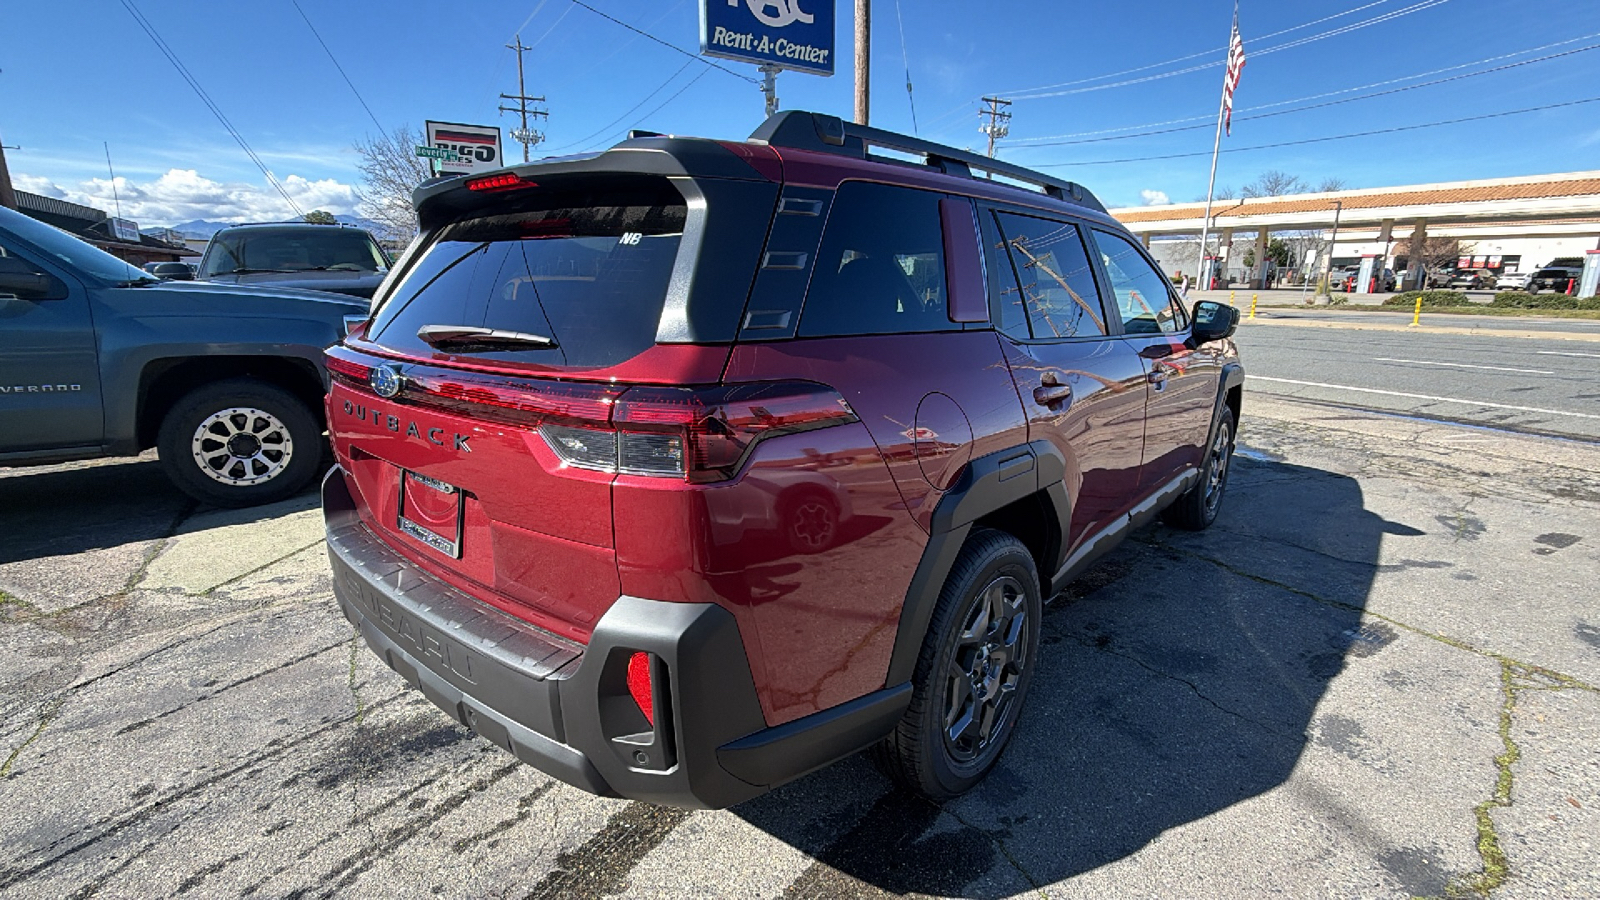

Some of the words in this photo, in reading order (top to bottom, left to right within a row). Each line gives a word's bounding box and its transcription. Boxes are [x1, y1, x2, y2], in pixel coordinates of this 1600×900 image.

[416, 146, 448, 159] Beverly
[619, 232, 643, 245] NB
[344, 400, 472, 453] OUTBACK
[345, 571, 477, 685] SUBARU
